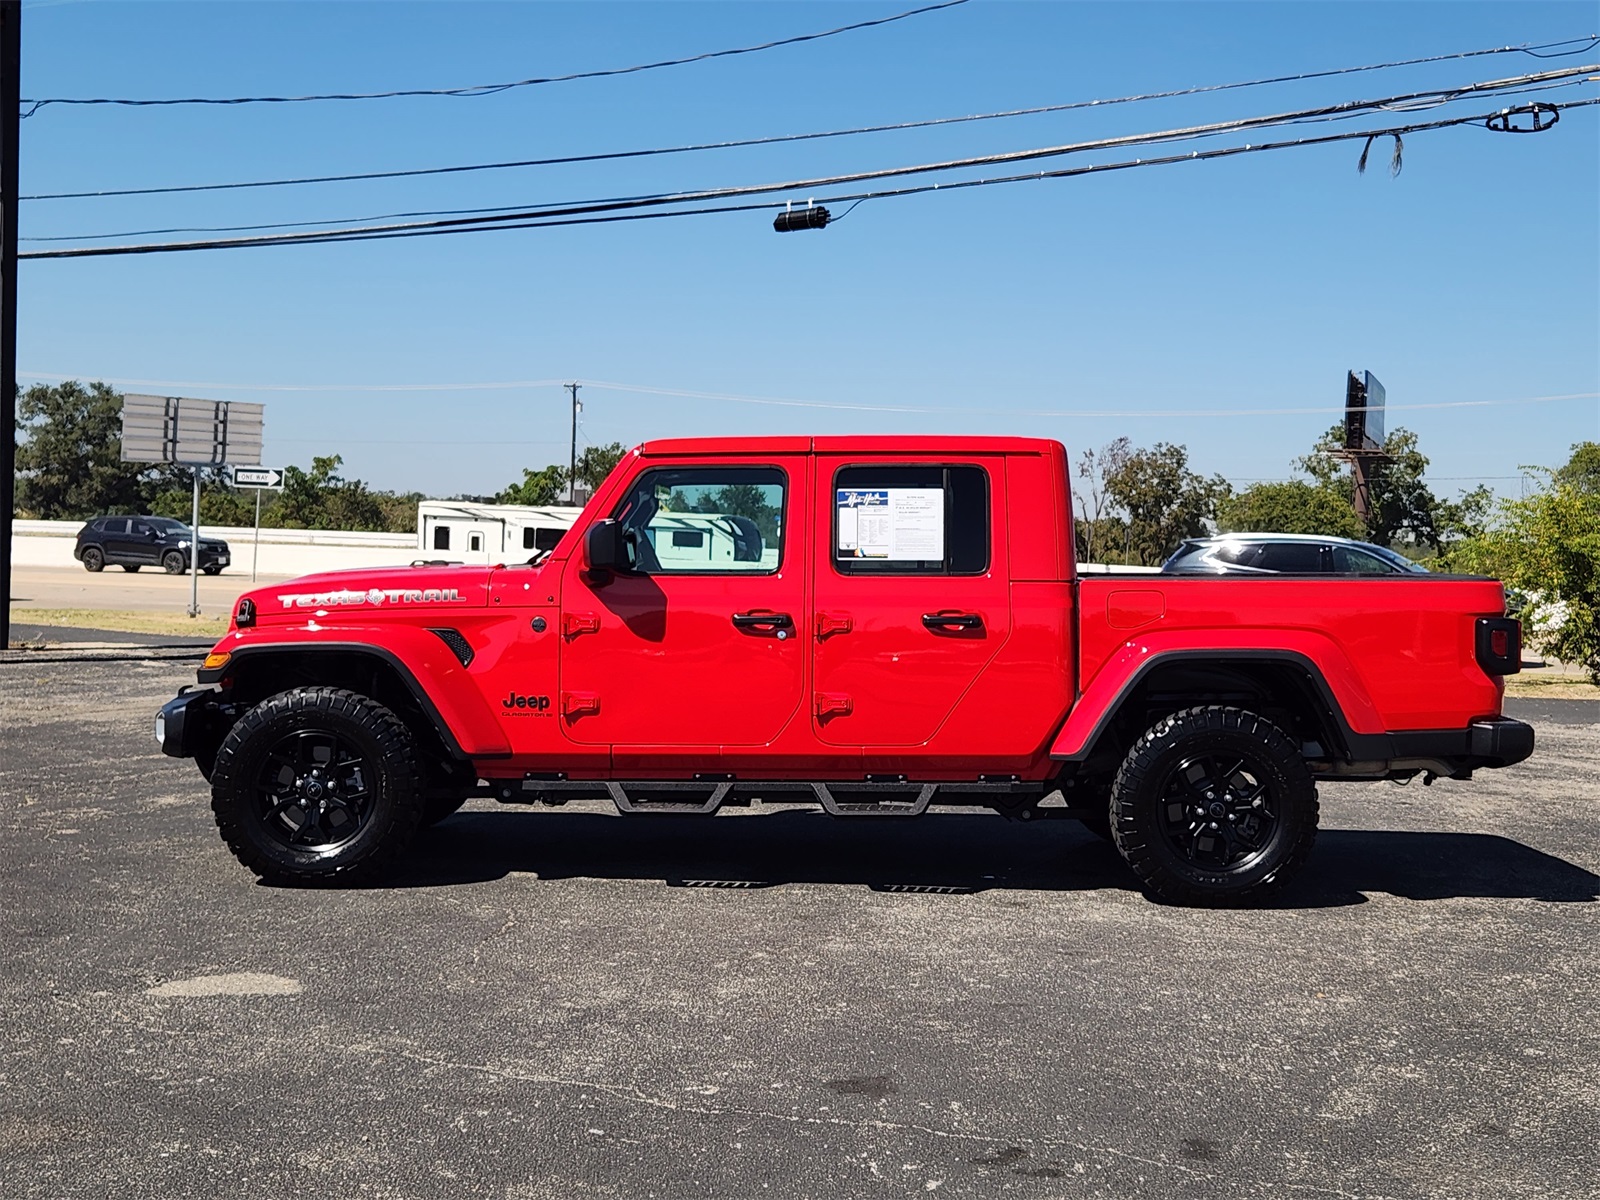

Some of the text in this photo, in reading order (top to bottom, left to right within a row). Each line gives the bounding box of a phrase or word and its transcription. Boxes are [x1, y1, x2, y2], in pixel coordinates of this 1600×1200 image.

[277, 588, 467, 609] TEXAS TRAIL
[502, 691, 551, 711] Jeep
